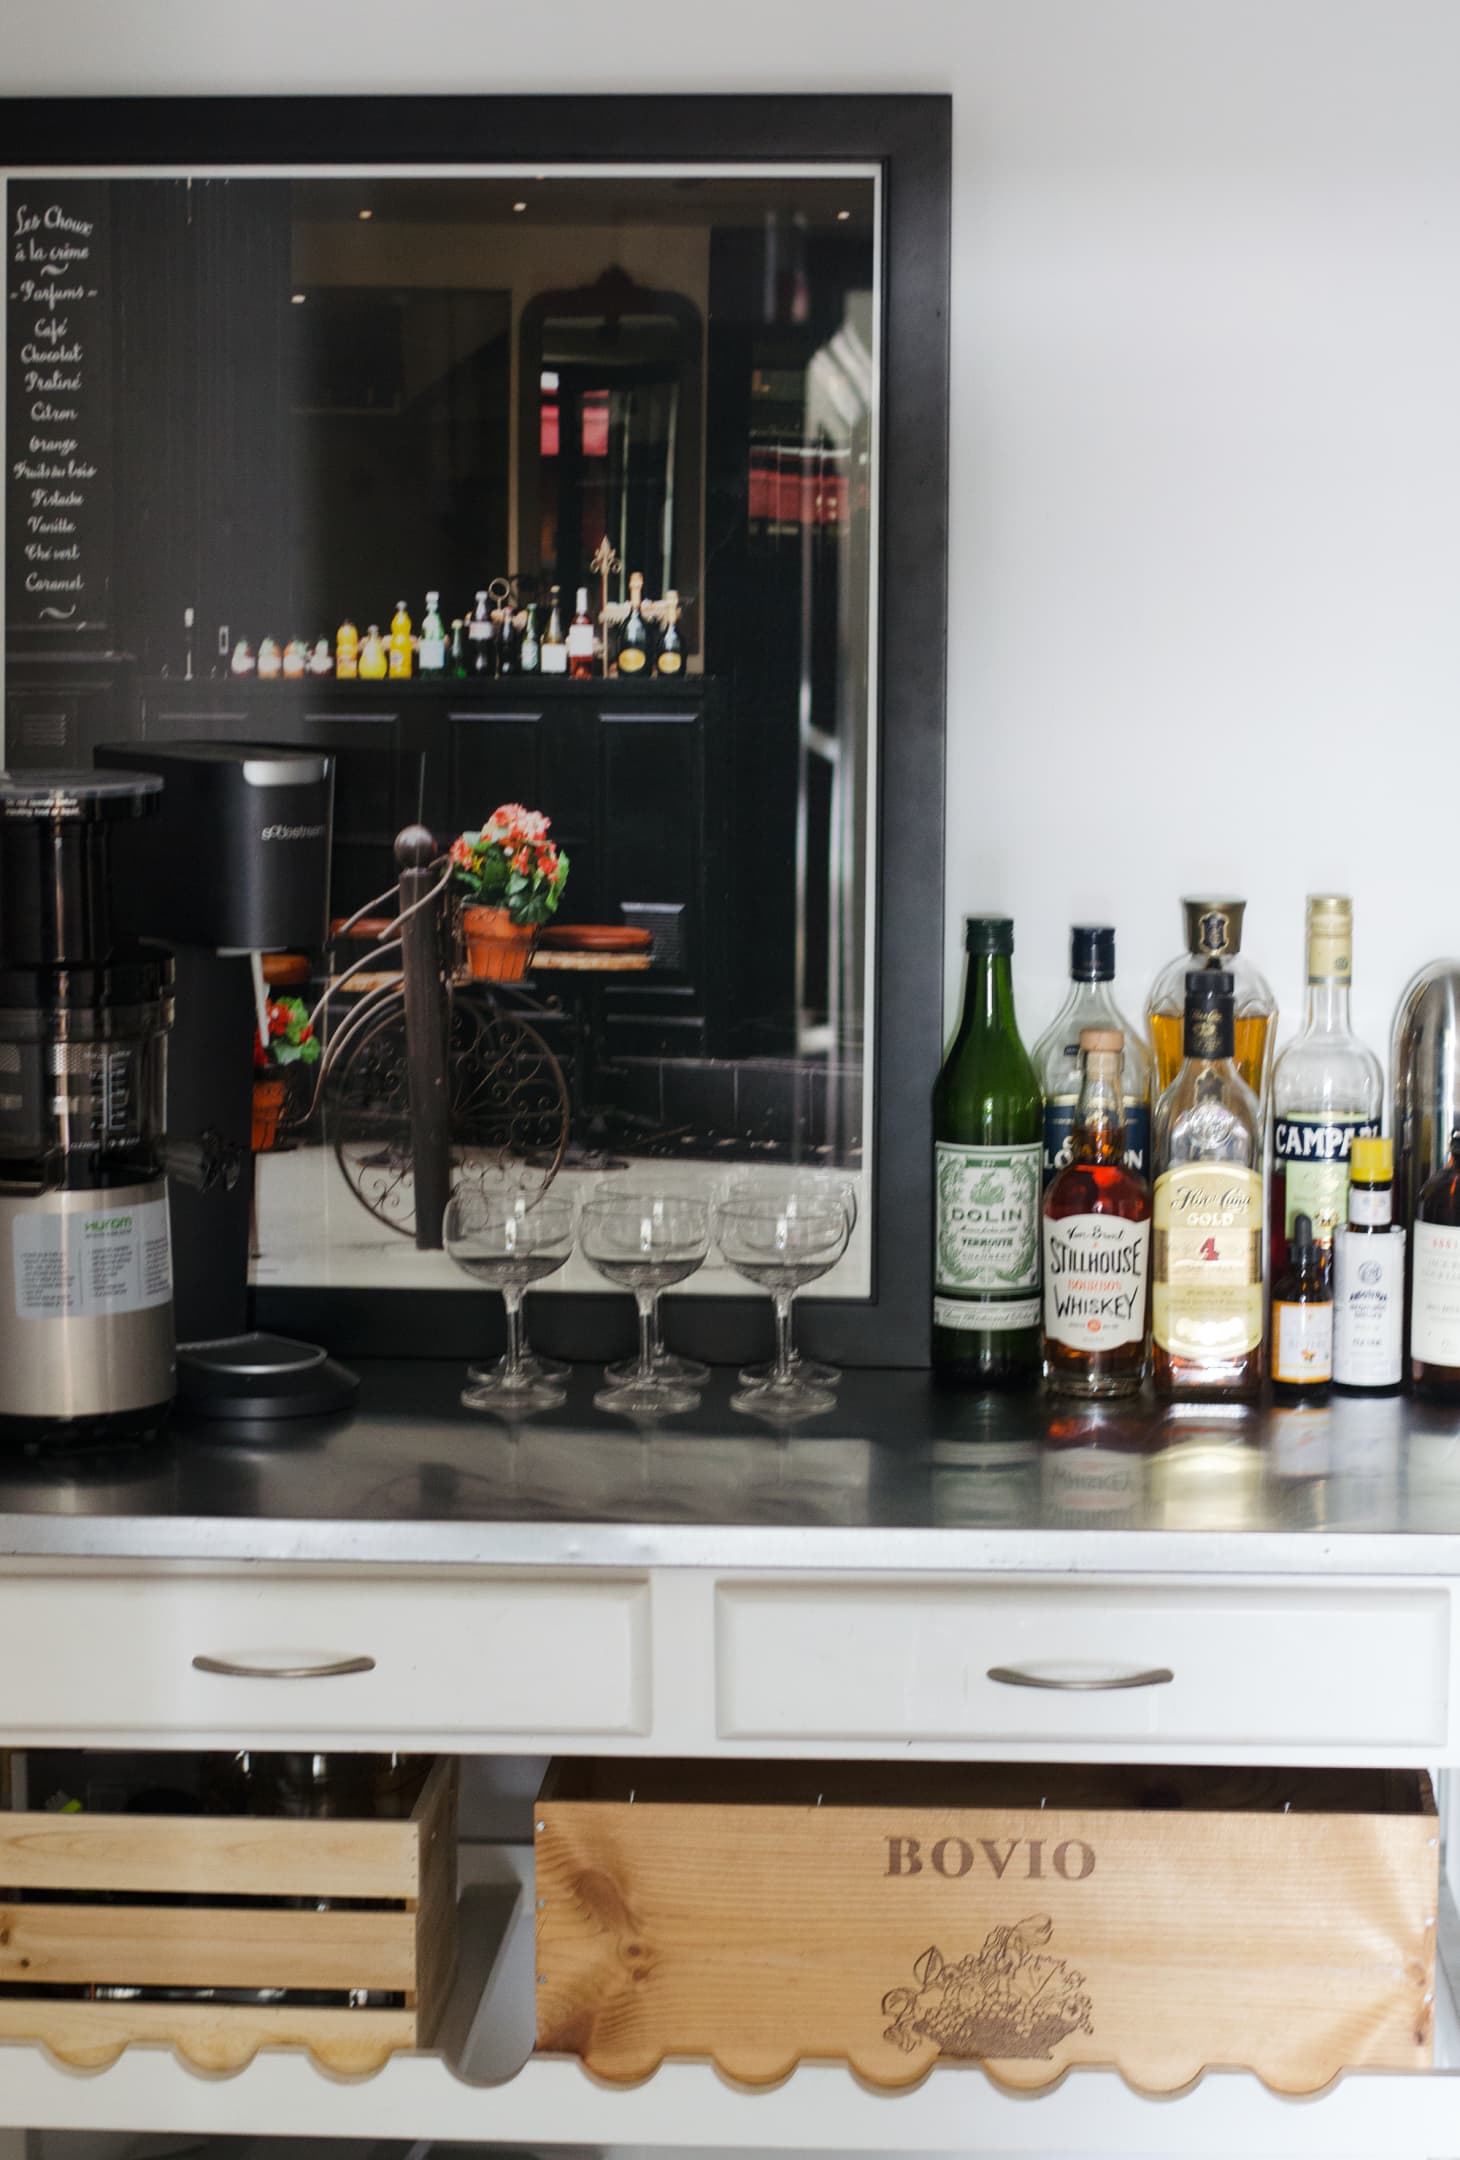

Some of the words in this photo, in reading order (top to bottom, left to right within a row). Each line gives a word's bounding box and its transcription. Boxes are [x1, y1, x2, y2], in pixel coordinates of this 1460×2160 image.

[44, 204, 94, 238] Choux
[30, 237, 46, 262] la
[20, 280, 84, 311] Parfums
[34, 317, 69, 346] Café
[20, 343, 83, 364] Chocolat
[31, 401, 78, 422] Citron
[29, 435, 78, 456] Orange
[27, 515, 76, 534] Vanille
[25, 571, 84, 593] Caramel
[951, 1206, 1022, 1221] DOLIN
[1186, 1212, 1234, 1226] GOLD
[1050, 1236, 1142, 1276] STILLHOUSE
[1054, 1284, 1139, 1320] WHISKEY
[884, 1835, 1096, 1881] BOVIO
